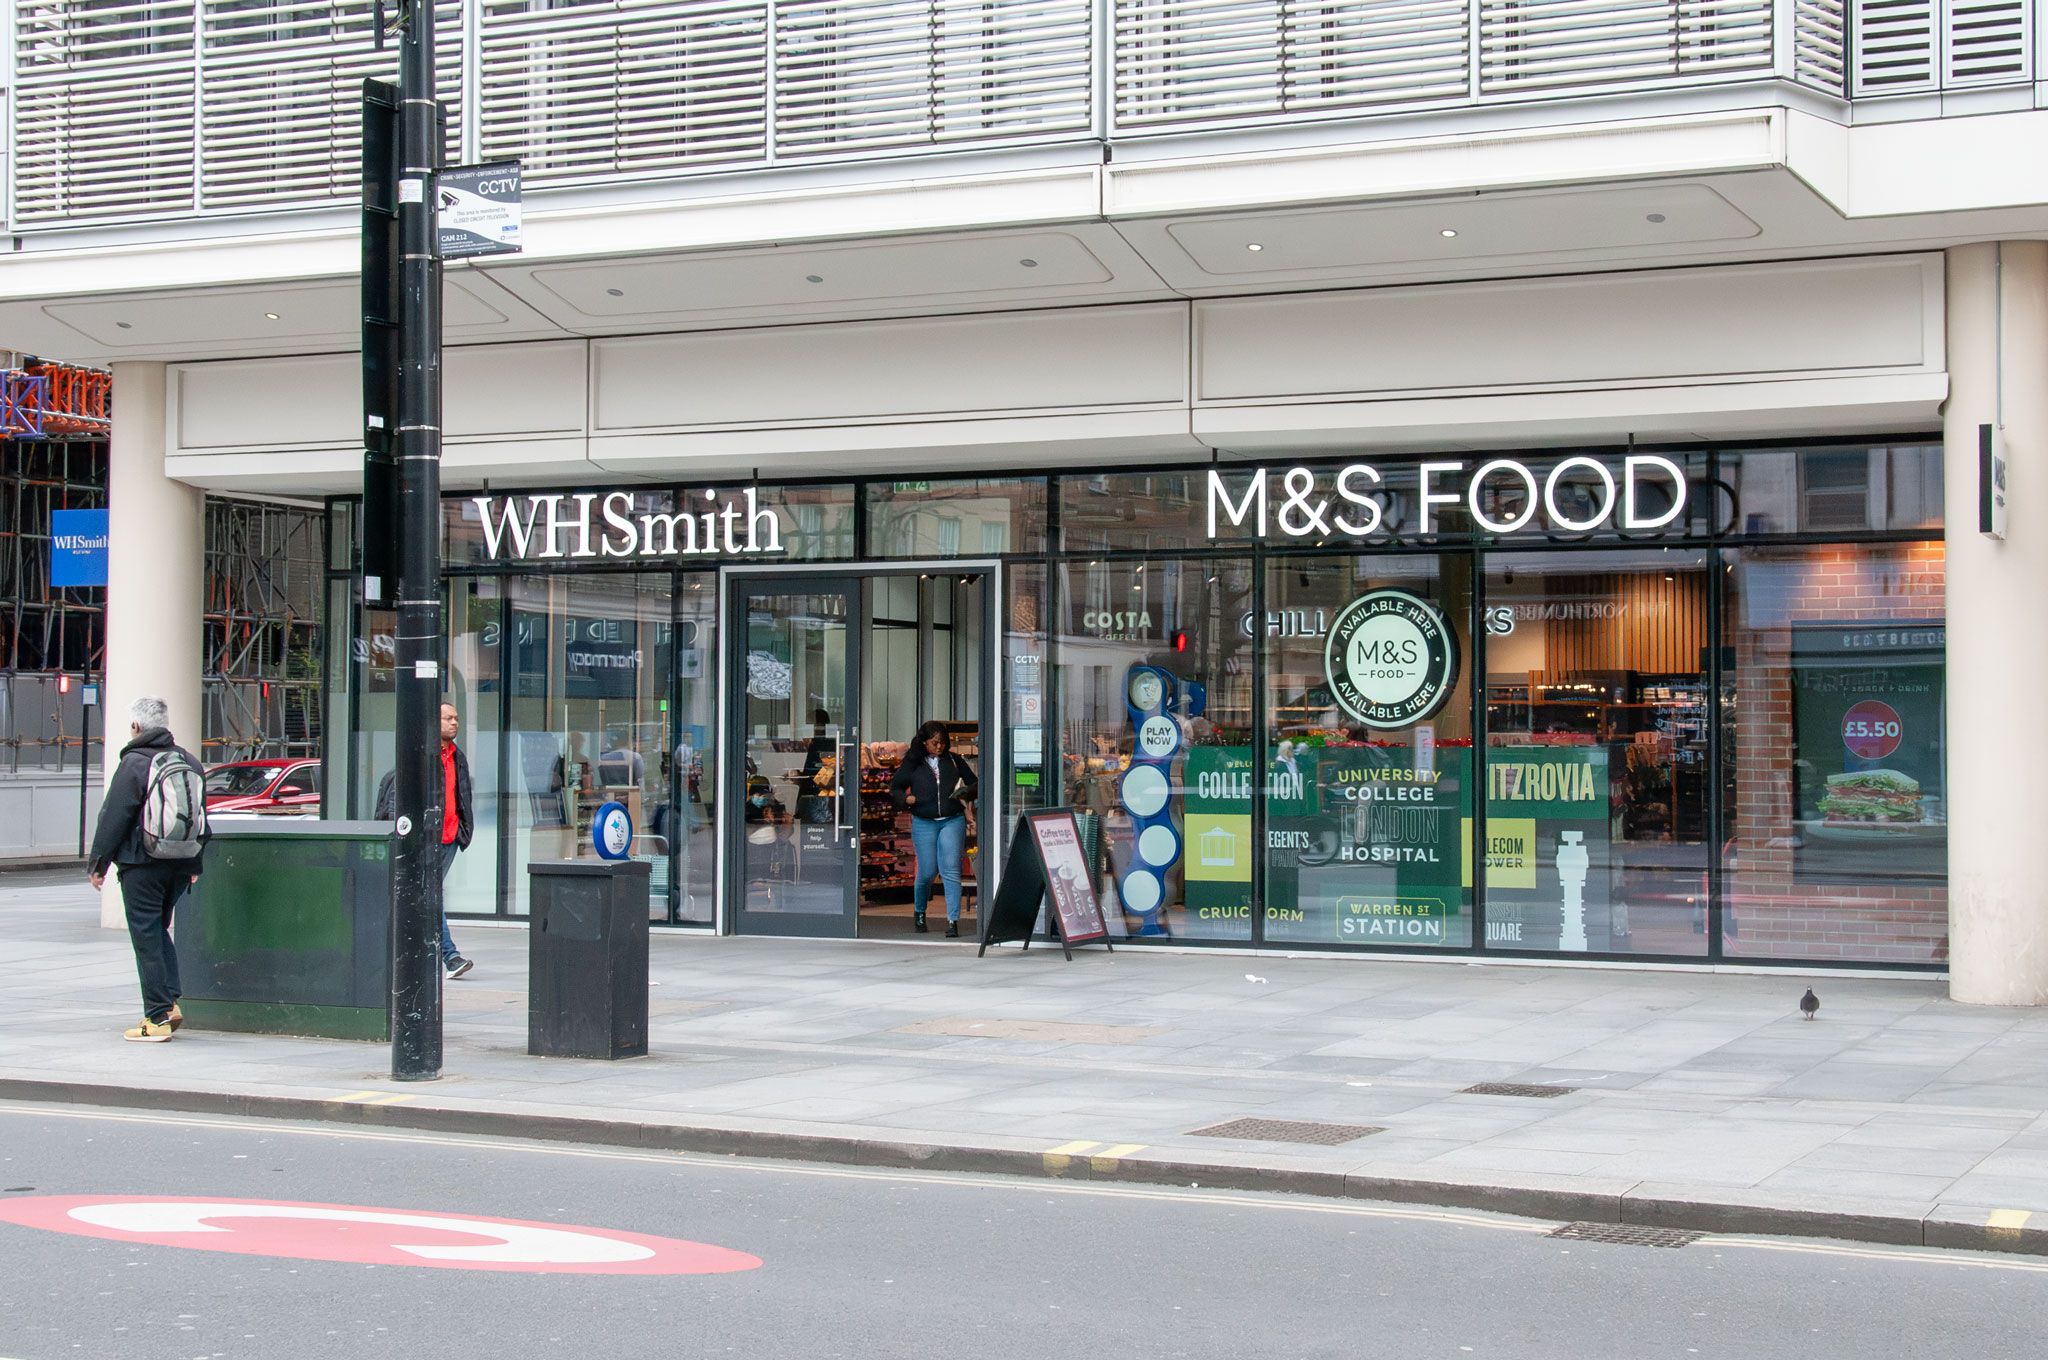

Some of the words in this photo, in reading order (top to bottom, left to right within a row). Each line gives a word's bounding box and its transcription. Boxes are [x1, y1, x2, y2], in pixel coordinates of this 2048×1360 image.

[478, 178, 518, 195] CCTV
[1206, 464, 1383, 538] M&S
[1419, 455, 1688, 534] FOOD
[472, 487, 784, 560] WHSmith
[1083, 612, 1152, 630] COSTA
[1340, 600, 1404, 640] AVAILABLE
[1408, 607, 1438, 639] HERE
[1015, 655, 1040, 664] CCTV
[1358, 639, 1417, 664] M&S
[1370, 669, 1404, 679] FOOD
[1338, 681, 1402, 719] AVAILABLE
[1405, 682, 1436, 713] HERE
[1146, 727, 1171, 736] PLAY
[1845, 721, 1899, 738] £5.50
[1146, 737, 1171, 745] NOW
[1338, 768, 1442, 784] UNIVERSITY
[1488, 763, 1596, 801] ITZROVIA
[1198, 771, 1304, 800] COLLETION
[1344, 786, 1434, 801] COLLEGE
[1340, 805, 1439, 844] LONDON
[1268, 830, 1309, 848] EGENT'S
[1487, 838, 1524, 855] LECOM
[1341, 846, 1440, 862] HOSPITAL
[1485, 858, 1523, 868] OWER
[1350, 903, 1412, 916] WARREN
[1417, 905, 1430, 915] ST
[1343, 917, 1439, 936] STATION
